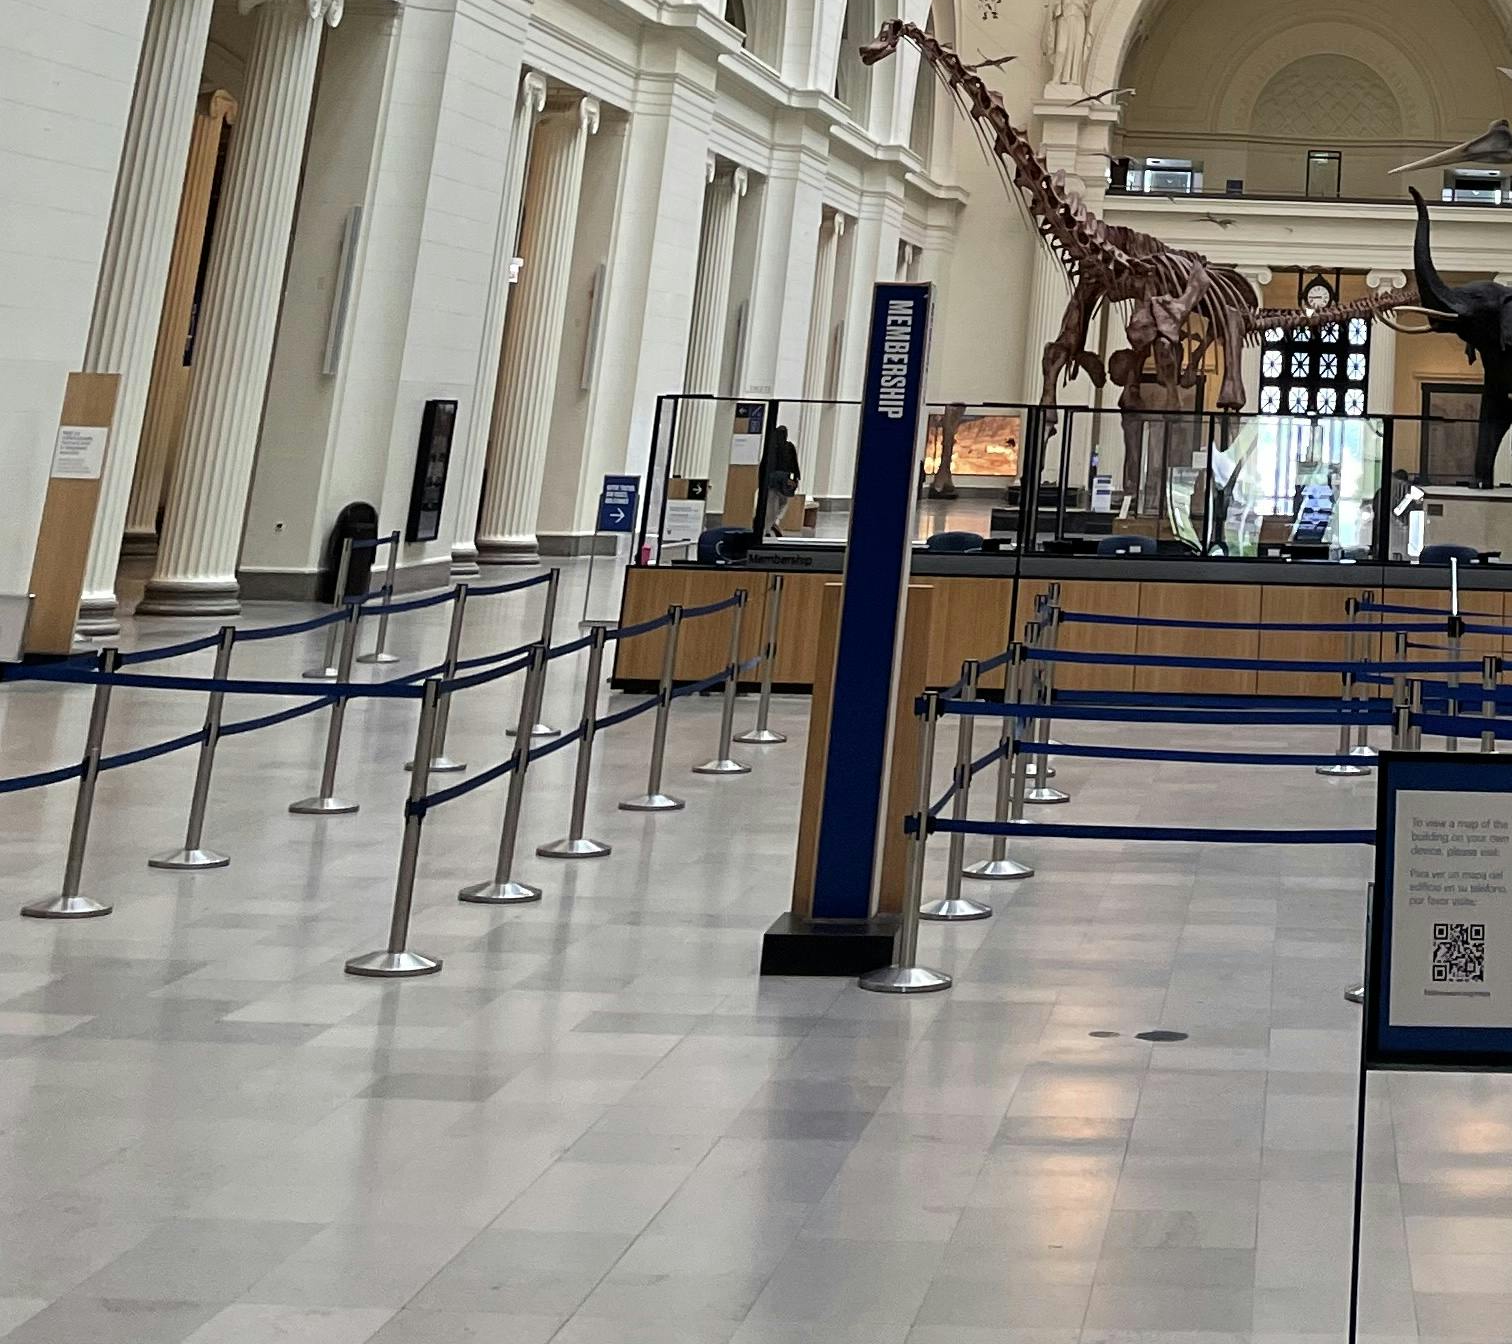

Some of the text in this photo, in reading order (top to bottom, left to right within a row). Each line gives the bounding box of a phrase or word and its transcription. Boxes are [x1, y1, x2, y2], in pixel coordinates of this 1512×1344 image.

[878, 300, 914, 419] MEMBERSHIP
[749, 554, 812, 566] Membership
[1412, 817, 1423, 828] To
[1457, 820, 1479, 830] map
[1480, 819, 1491, 829] of
[1493, 820, 1509, 830] the
[1411, 832, 1449, 843] building
[1451, 835, 1464, 843] on
[1466, 836, 1487, 845] your
[1431, 871, 1446, 879] ver
